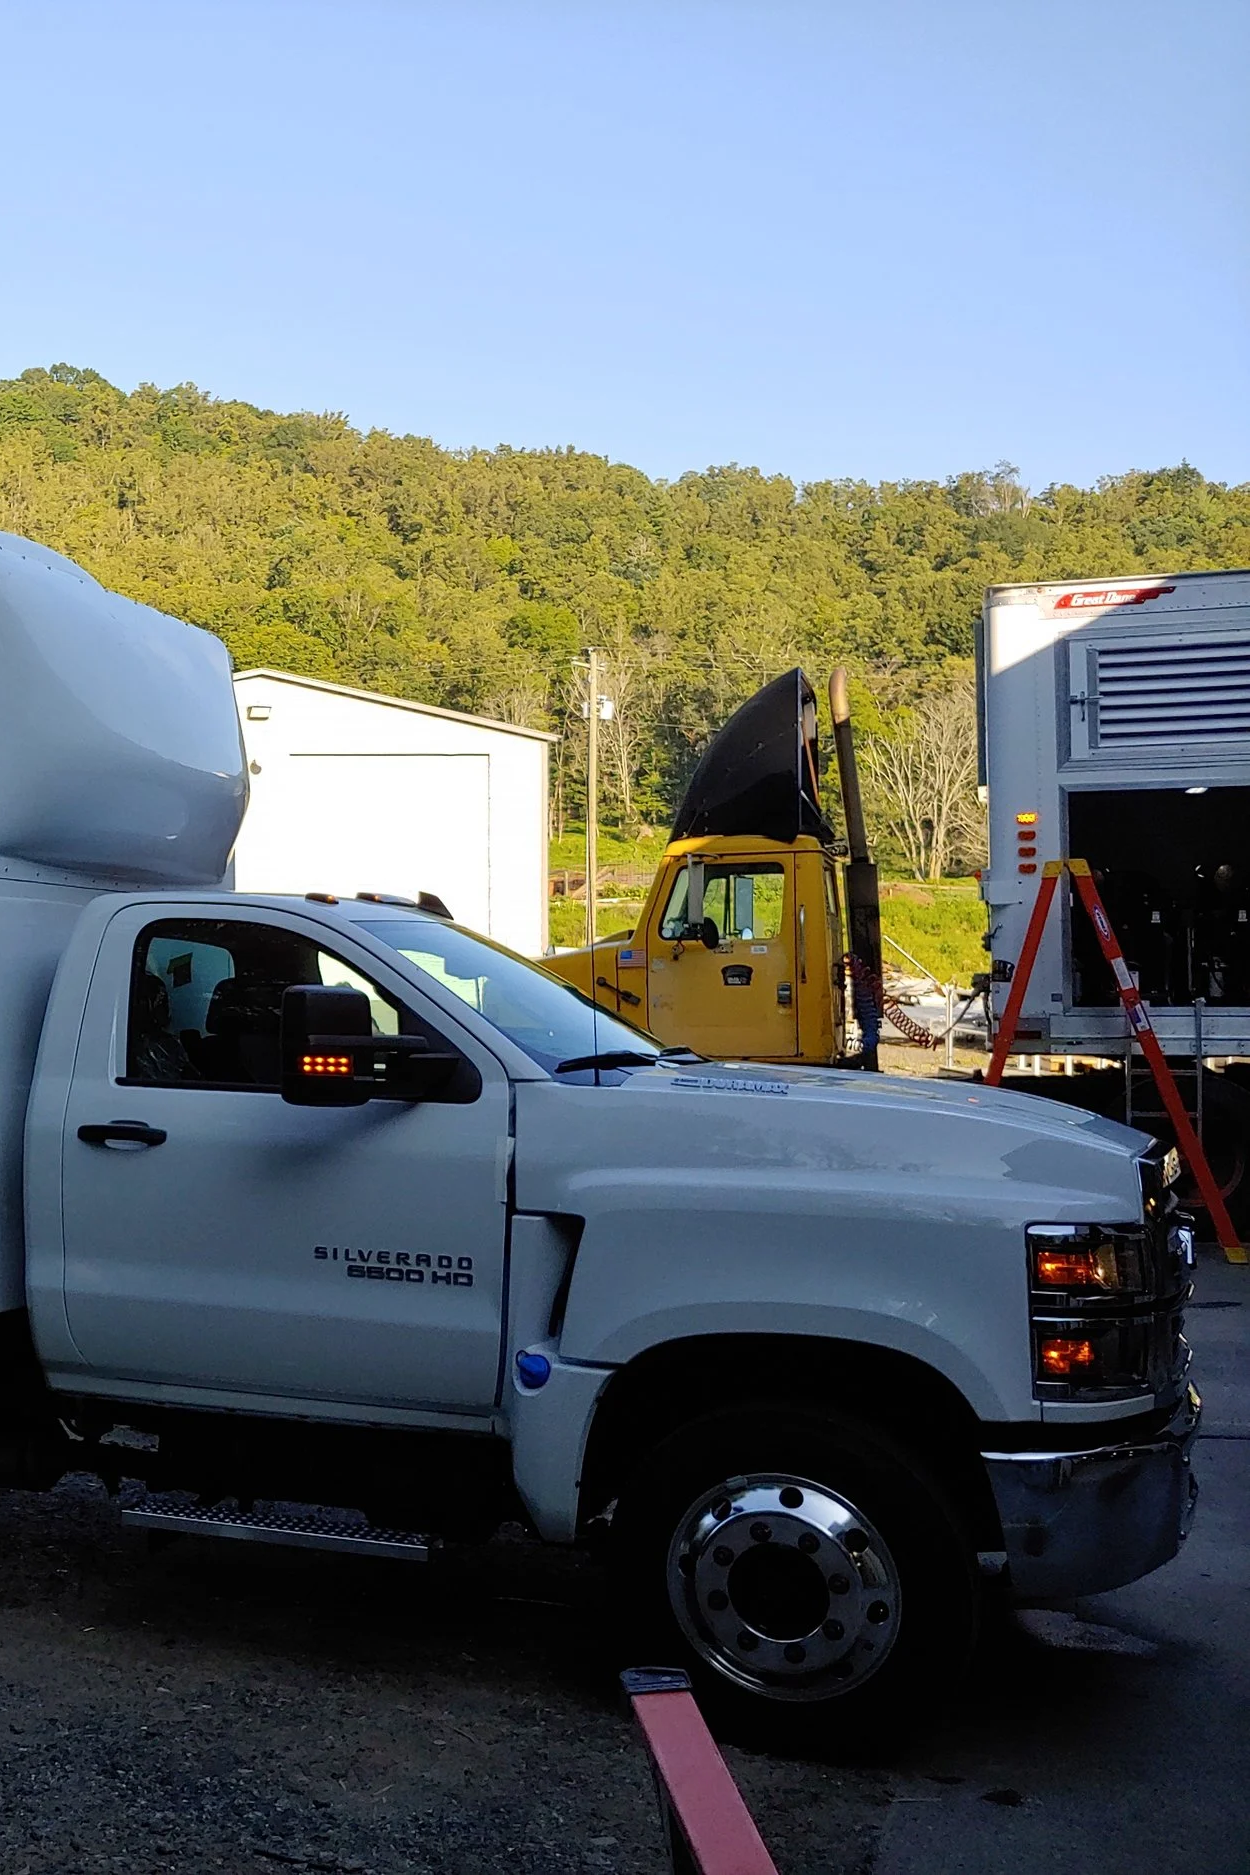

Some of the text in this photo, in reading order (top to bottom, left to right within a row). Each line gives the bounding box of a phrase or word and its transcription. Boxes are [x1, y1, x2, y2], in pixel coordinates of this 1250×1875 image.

[1071, 591, 1136, 606] Great Dane
[314, 1246, 472, 1270] SILVERADO
[432, 1270, 473, 1287] HD
